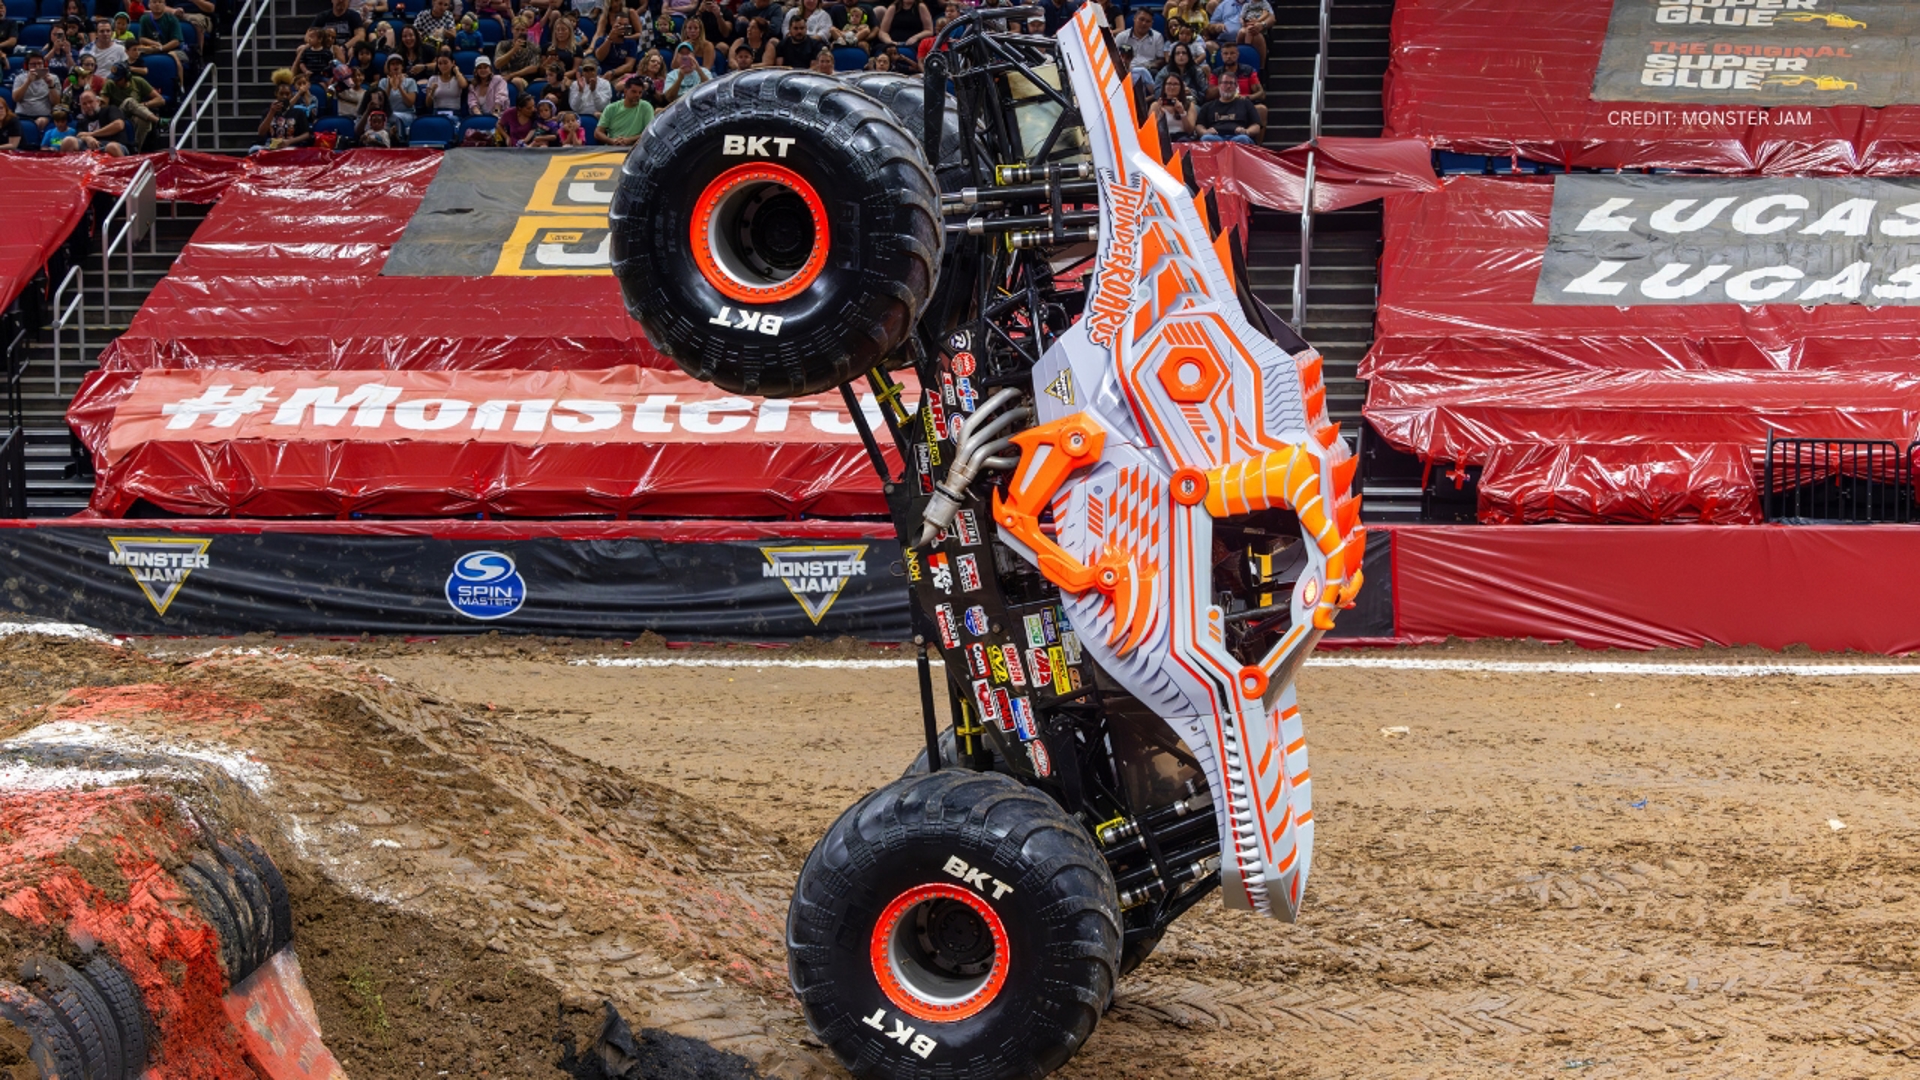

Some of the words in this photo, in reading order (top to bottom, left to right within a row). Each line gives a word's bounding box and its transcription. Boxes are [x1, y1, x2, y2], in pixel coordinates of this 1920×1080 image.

[1656, 6, 1776, 26] GLUE
[1645, 54, 1808, 71] SUPER
[1650, 41, 1703, 55] THE
[1712, 42, 1853, 58] ORIGINAL
[1641, 68, 1766, 91] GLUE
[722, 134, 796, 158] BKT
[1562, 259, 1920, 302] LUCAS
[709, 305, 784, 336] BKT
[928, 391, 948, 440] ARP
[922, 408, 941, 466] MAGNAFLOW
[919, 443, 932, 477] Holley
[108, 551, 210, 569] MONSTER
[762, 560, 867, 577] MONSTER
[137, 568, 182, 583] JAM
[791, 577, 839, 593] JAM
[457, 585, 513, 598] SPIN
[458, 597, 513, 606] MASTER
[942, 602, 959, 642] LINCOLN
[971, 643, 985, 676] Coan
[1004, 646, 1023, 683] SIMPSON
[975, 681, 994, 718] WORLD
[942, 854, 1015, 901] BKT
[862, 1007, 938, 1059] BKT
